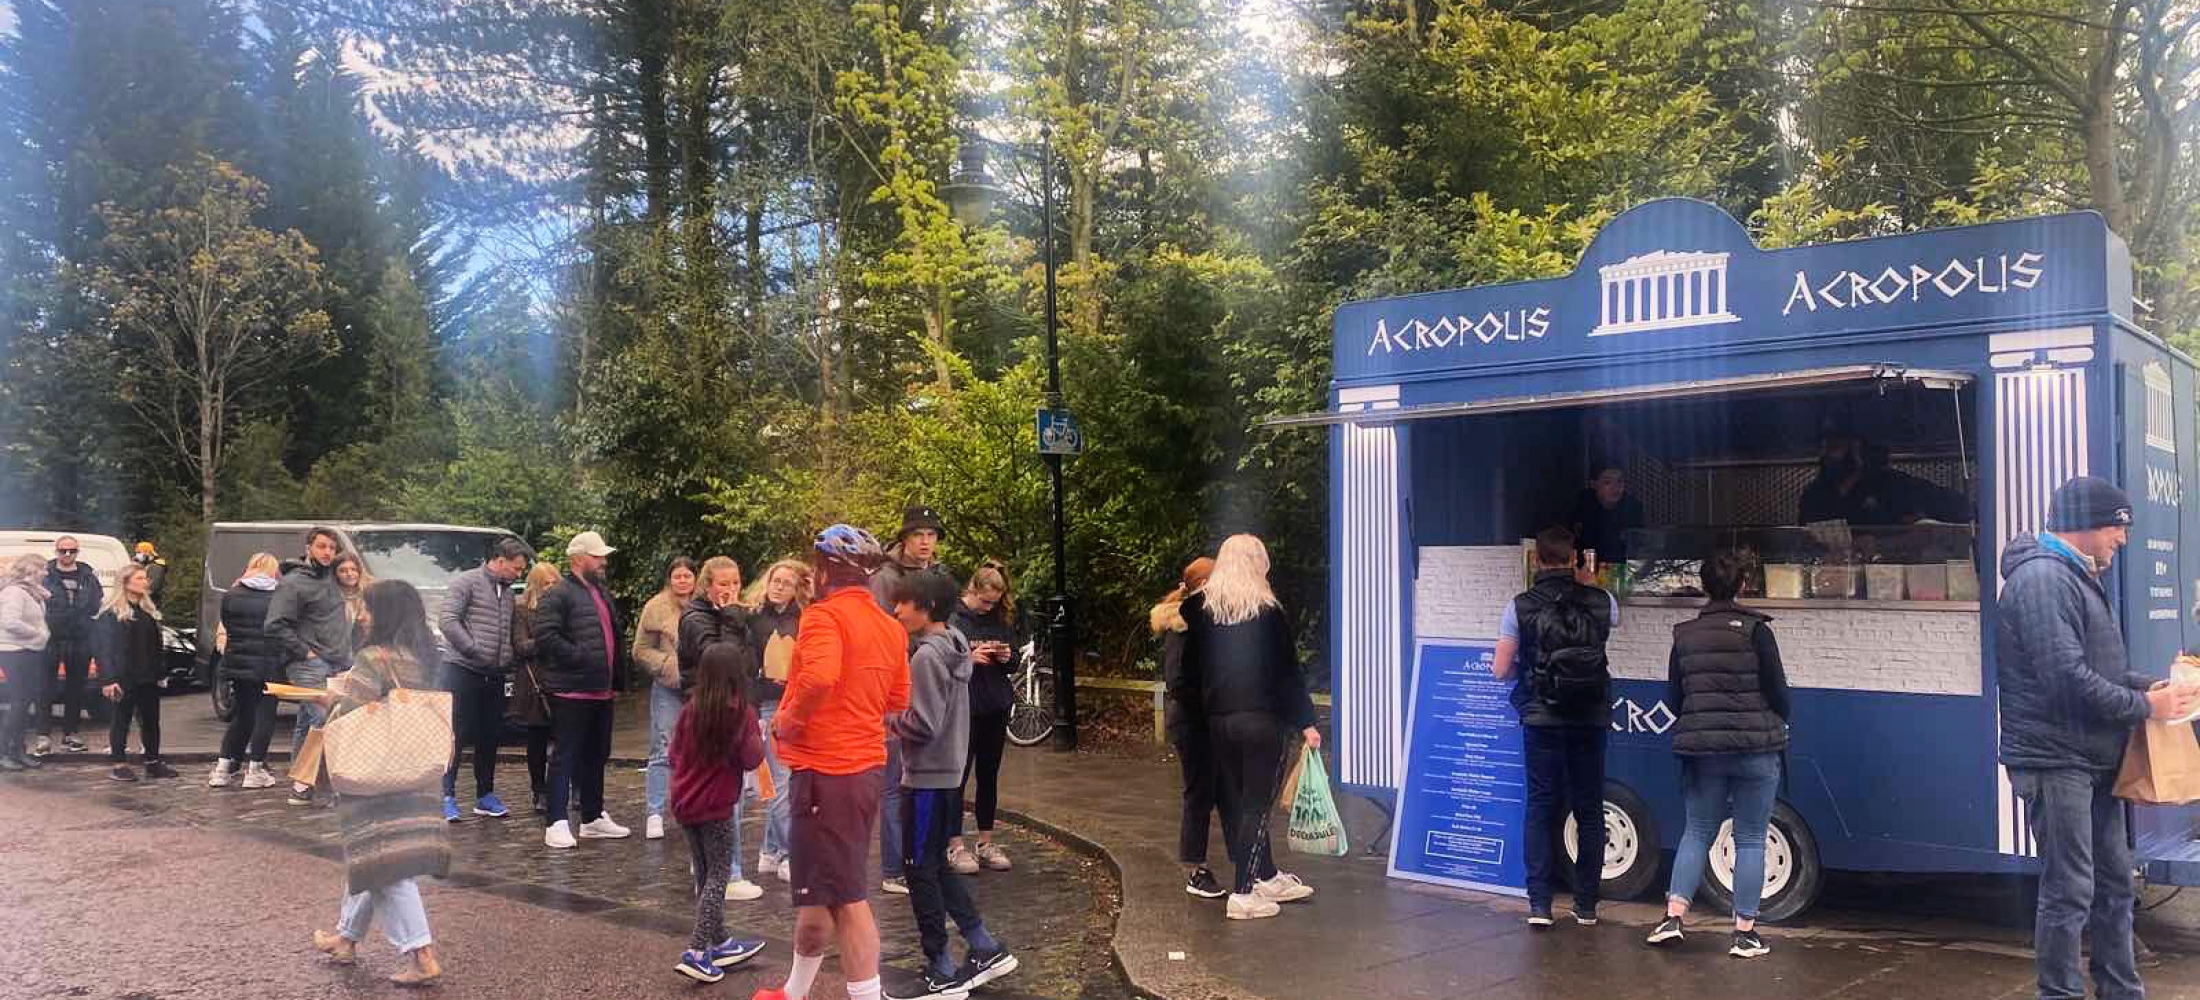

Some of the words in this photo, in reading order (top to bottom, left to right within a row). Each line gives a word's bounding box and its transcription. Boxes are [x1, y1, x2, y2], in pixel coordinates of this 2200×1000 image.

[1782, 251, 2045, 316] ACROPOLIS
[1368, 307, 1551, 356] ACROPOLIS
[1611, 696, 1678, 734] CRO
